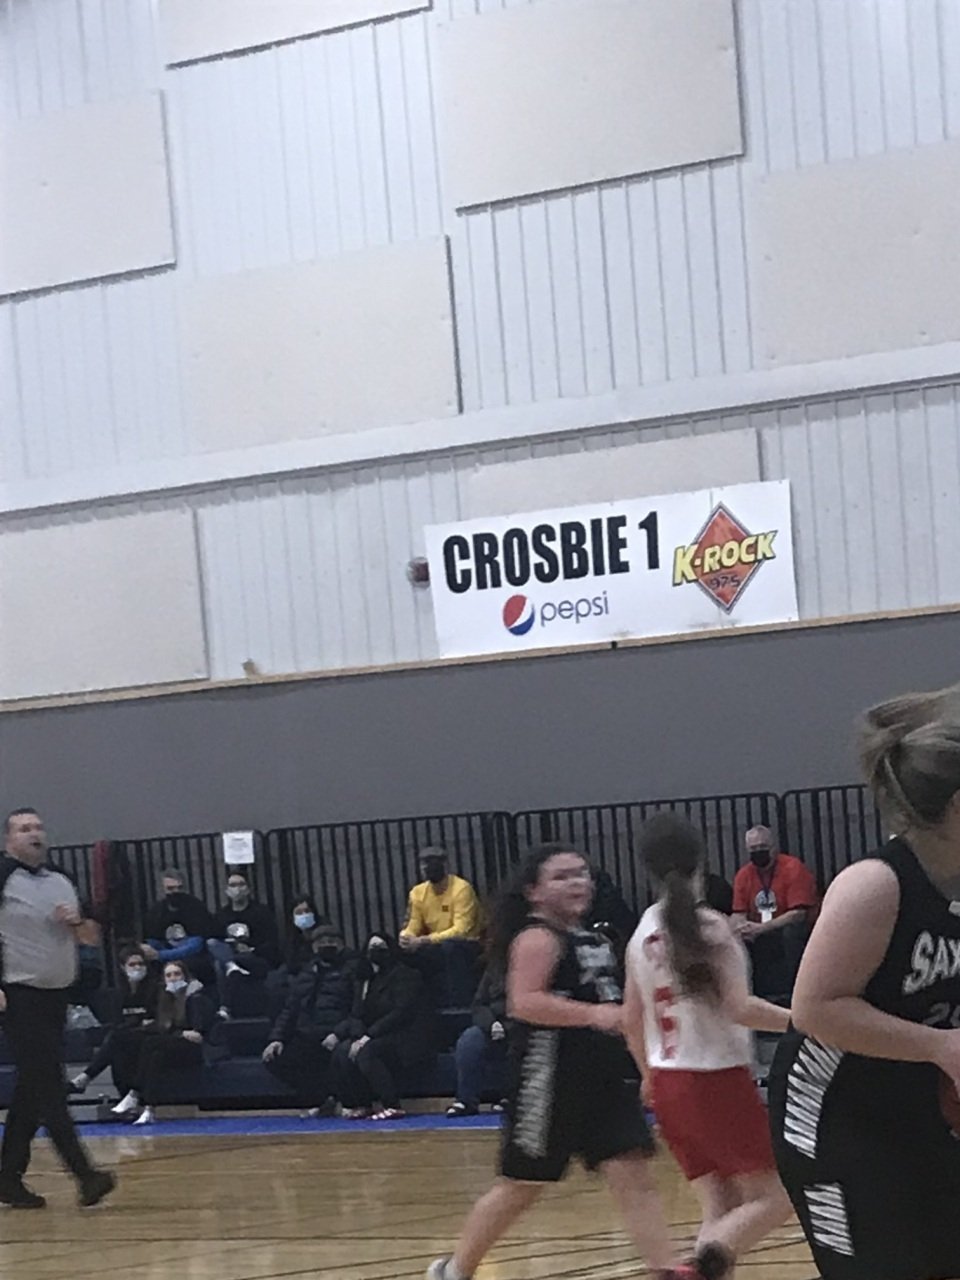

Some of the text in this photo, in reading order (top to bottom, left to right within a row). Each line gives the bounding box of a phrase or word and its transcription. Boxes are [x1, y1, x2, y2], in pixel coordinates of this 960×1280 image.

[443, 511, 660, 594] CROSBIE 1
[673, 530, 778, 587] K-ROCK
[540, 590, 610, 627] pepsi
